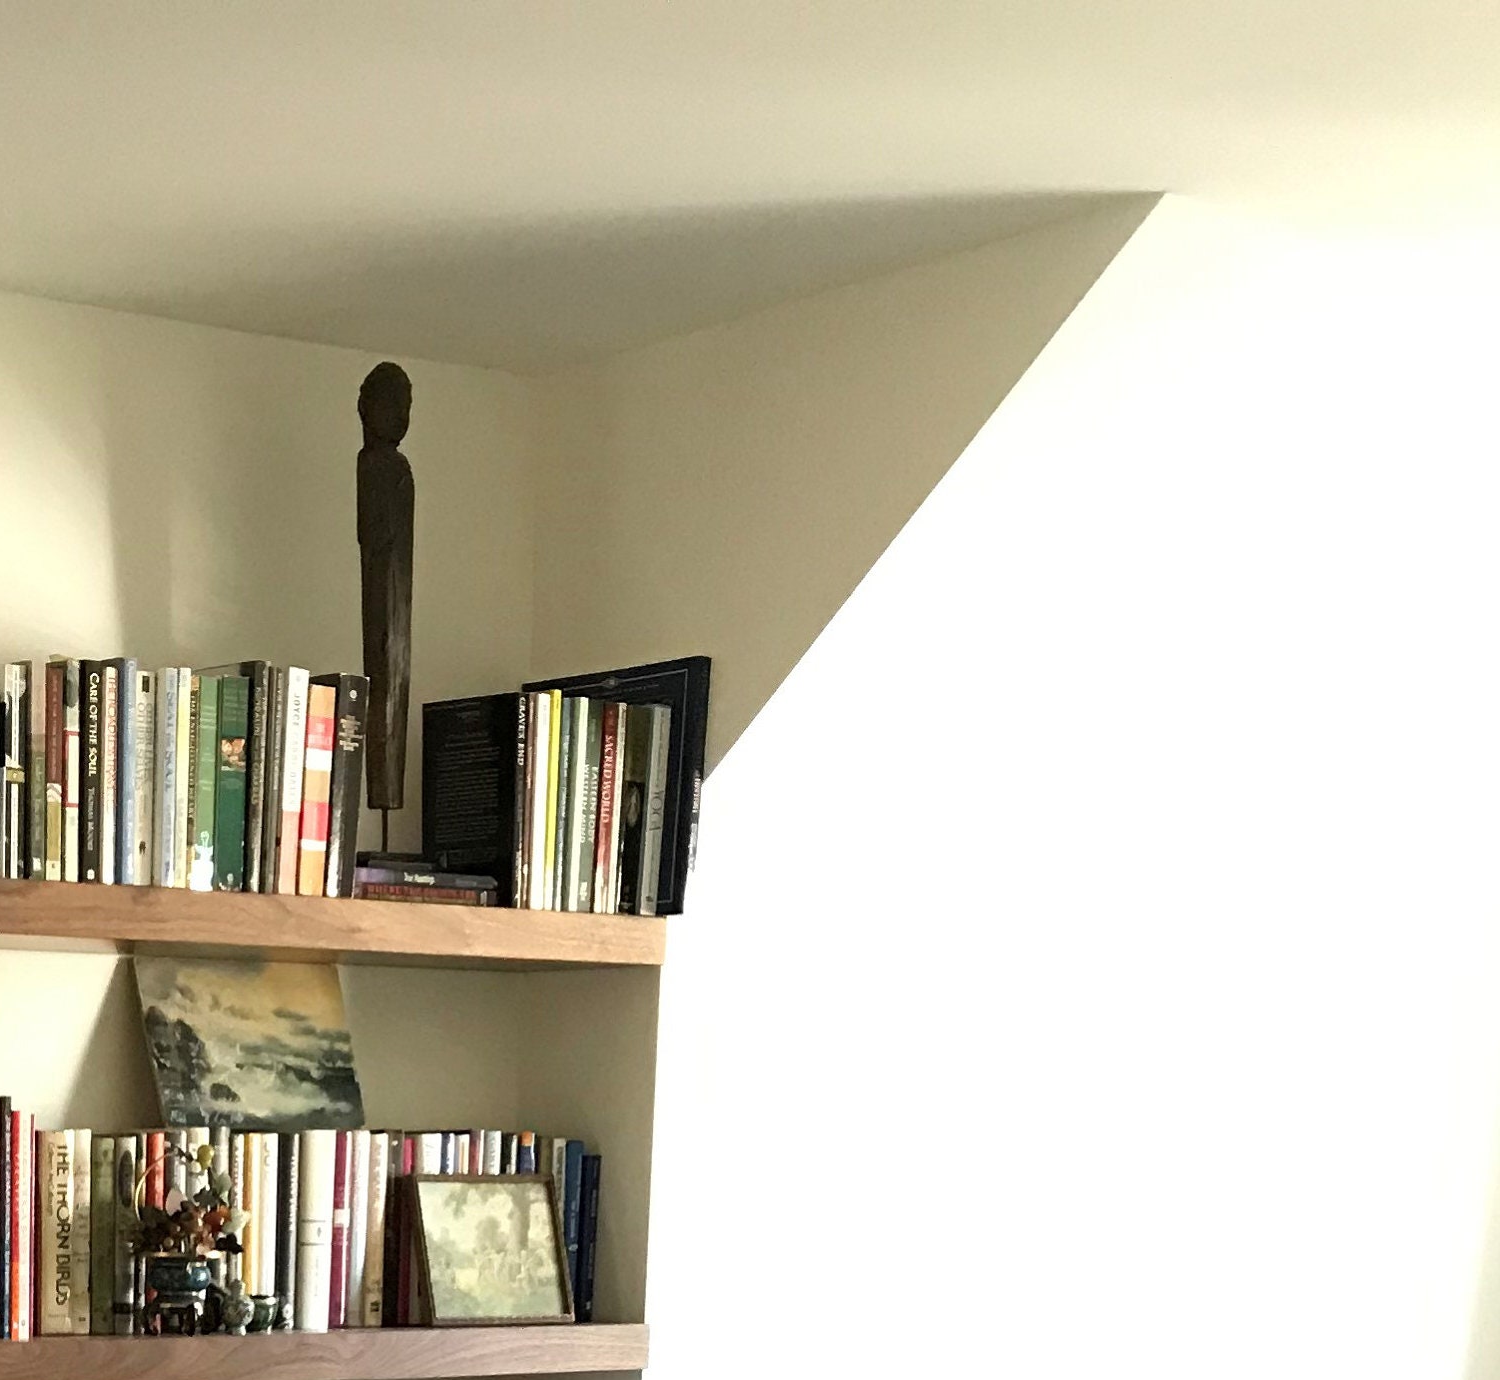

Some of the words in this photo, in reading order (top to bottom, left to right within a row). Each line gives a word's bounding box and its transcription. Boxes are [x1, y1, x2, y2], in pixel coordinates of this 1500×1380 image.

[89, 673, 99, 702] CARE
[89, 705, 99, 722] OF
[291, 693, 301, 726] JOYCE
[89, 724, 99, 745] THE
[88, 748, 99, 776] SOUL
[517, 744, 525, 765] END
[603, 735, 614, 778] SACRED
[602, 782, 612, 823] WORLD
[57, 1144, 69, 1175] THE
[57, 1183, 69, 1249] THORN
[56, 1254, 70, 1306] BIRDS
